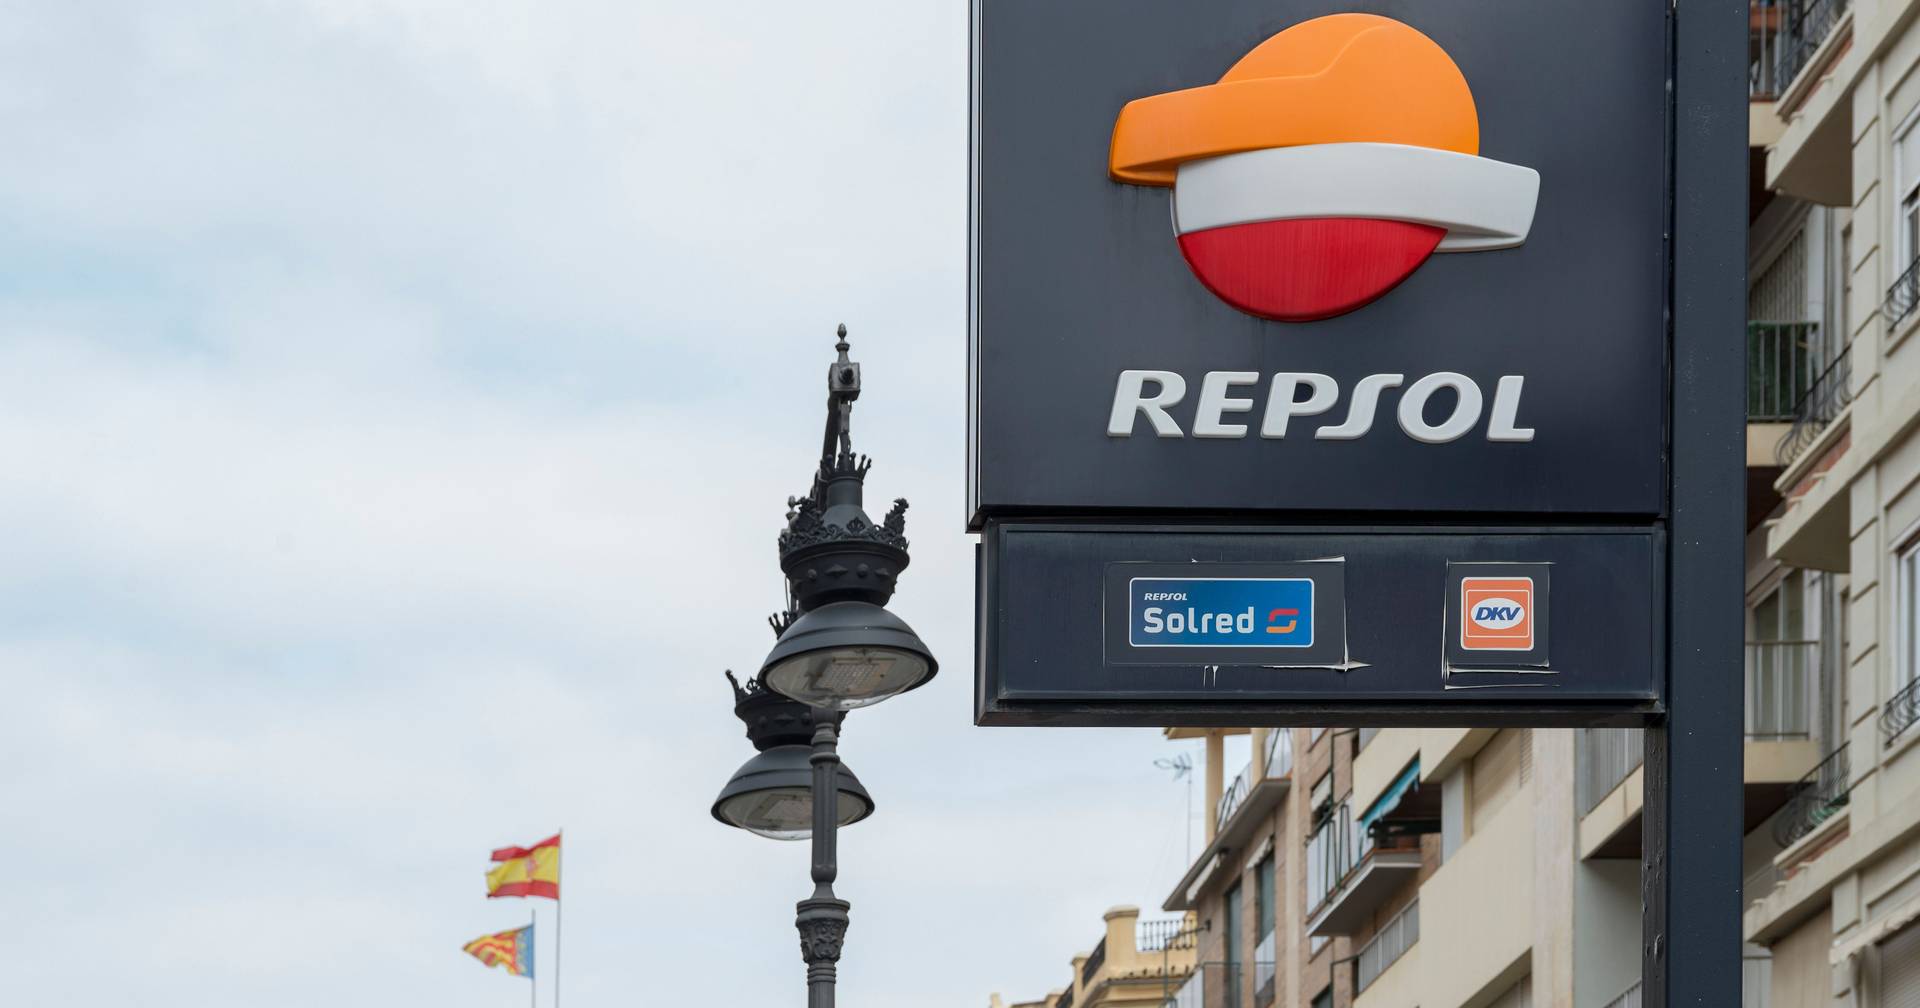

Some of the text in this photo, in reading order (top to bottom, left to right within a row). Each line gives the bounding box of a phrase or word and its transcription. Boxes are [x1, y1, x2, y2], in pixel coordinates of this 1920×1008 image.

[1107, 370, 1535, 443] REPSOL
[1144, 592, 1188, 601] REPSOL
[1143, 606, 1255, 634] Solred
[1475, 606, 1521, 621] DKV
